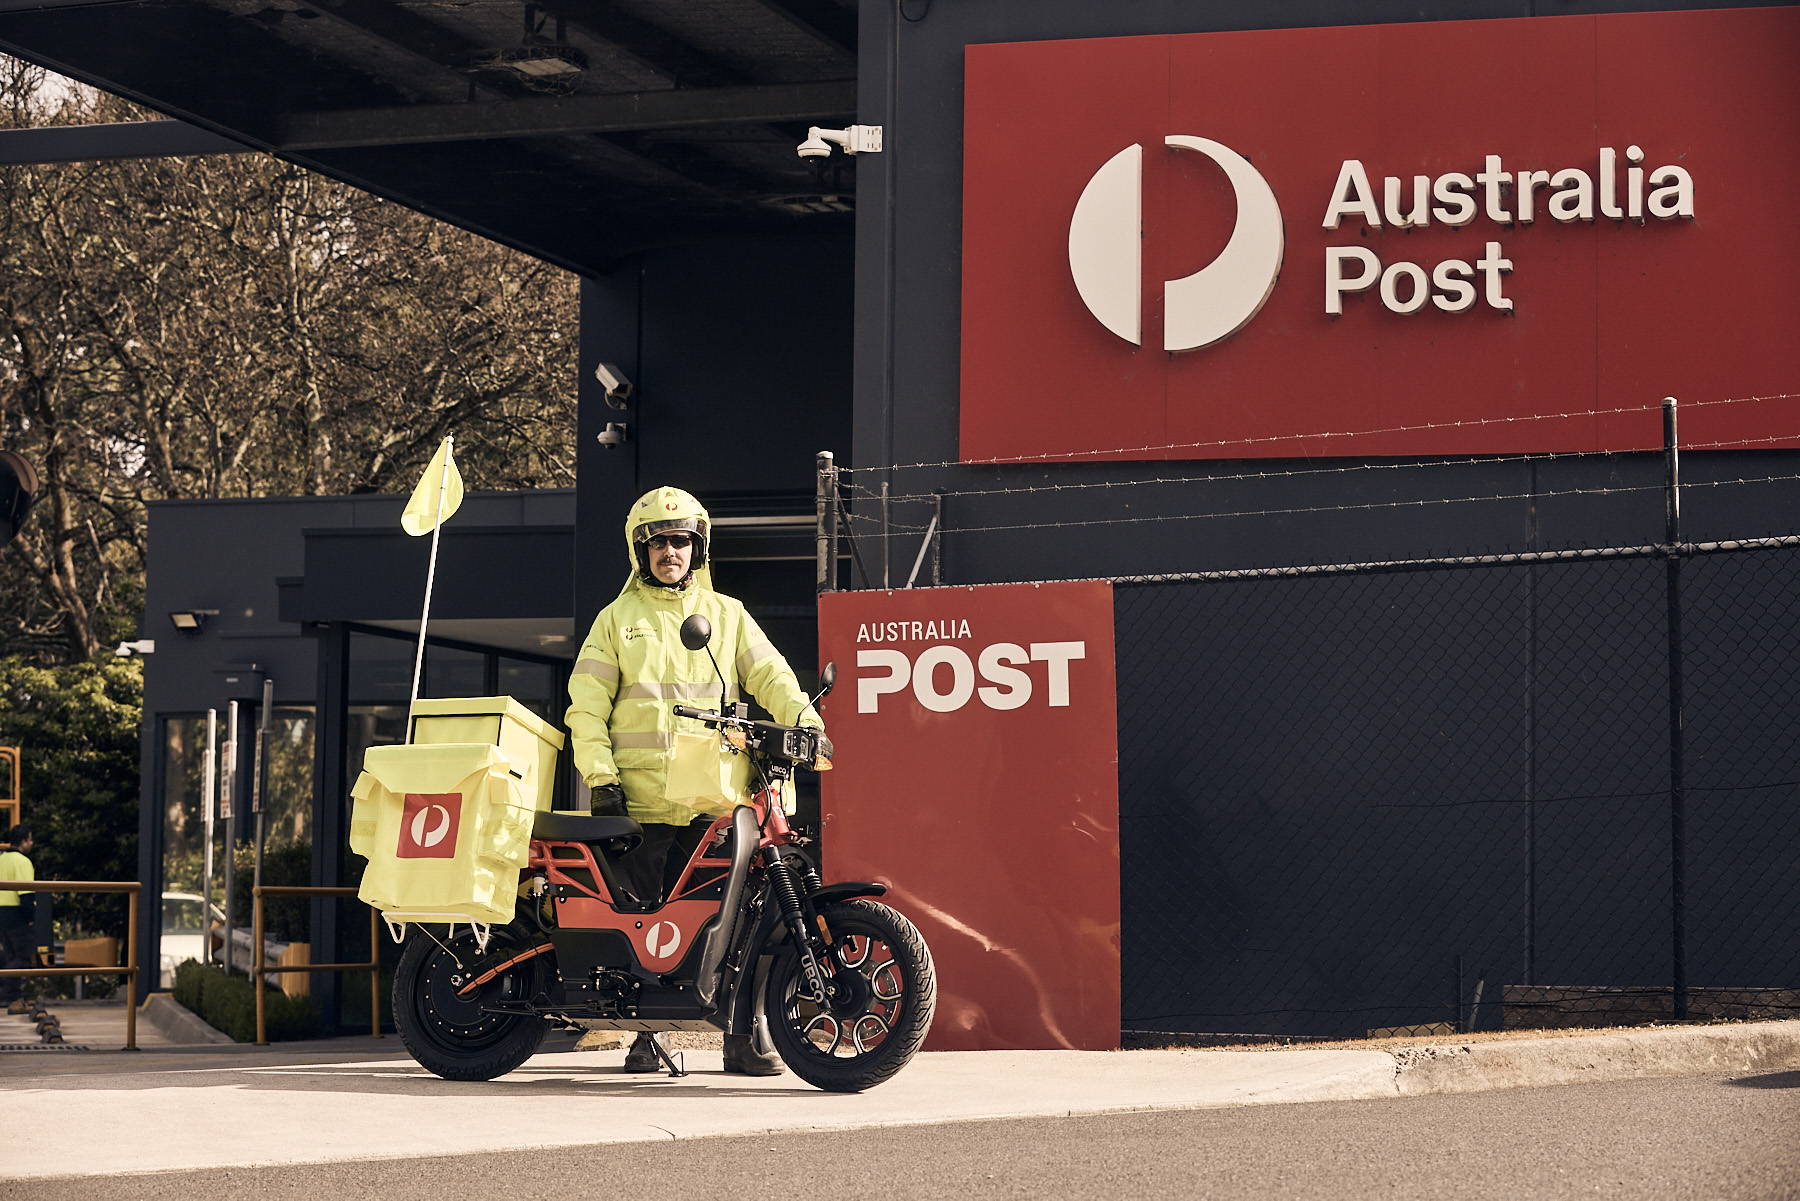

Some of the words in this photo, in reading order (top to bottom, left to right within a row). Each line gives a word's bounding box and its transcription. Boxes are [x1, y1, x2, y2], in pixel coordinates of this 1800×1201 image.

[1322, 145, 1694, 229] Australia
[1325, 241, 1513, 315] Post
[856, 618, 972, 643] AUSTRALIA
[856, 641, 1086, 714] POST
[801, 954, 824, 1003] UBCO
